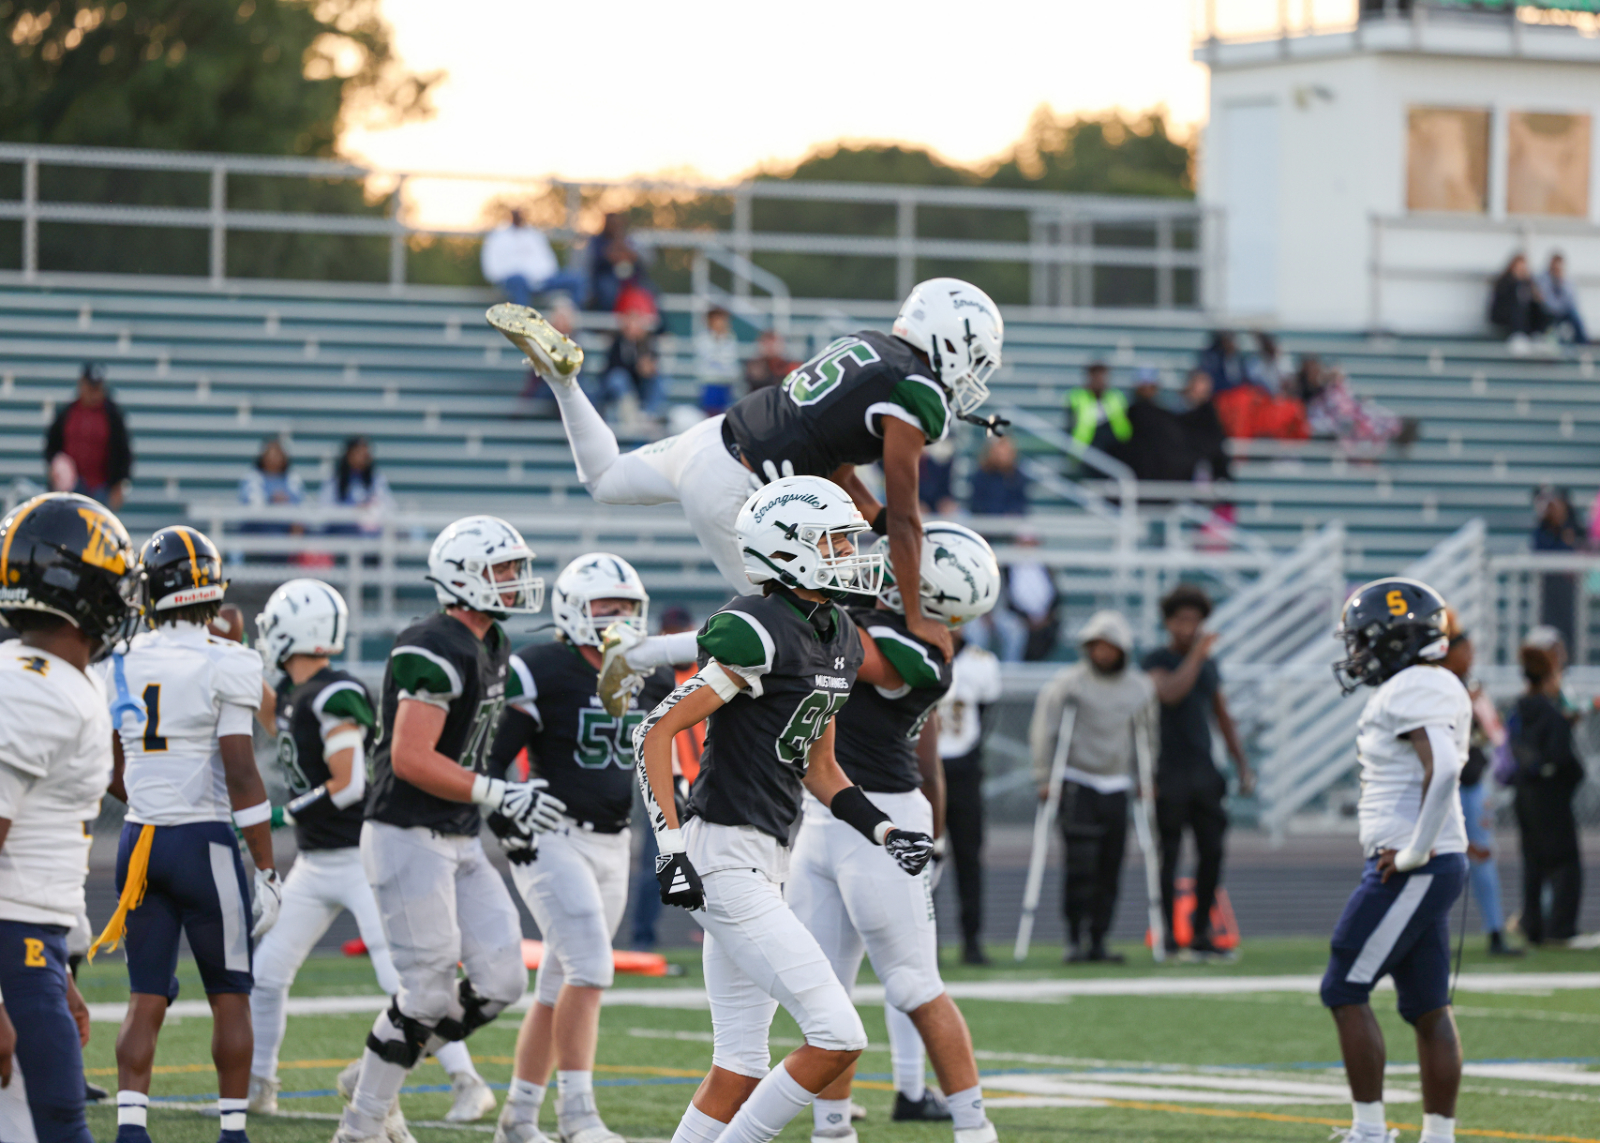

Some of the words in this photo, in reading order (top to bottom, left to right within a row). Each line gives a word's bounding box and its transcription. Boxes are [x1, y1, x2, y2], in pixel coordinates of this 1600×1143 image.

[754, 493, 820, 523] Strongsville
[815, 674, 849, 689] MUSTANGS
[142, 683, 168, 752] 1
[573, 707, 648, 770] 55
[24, 937, 47, 967] E
